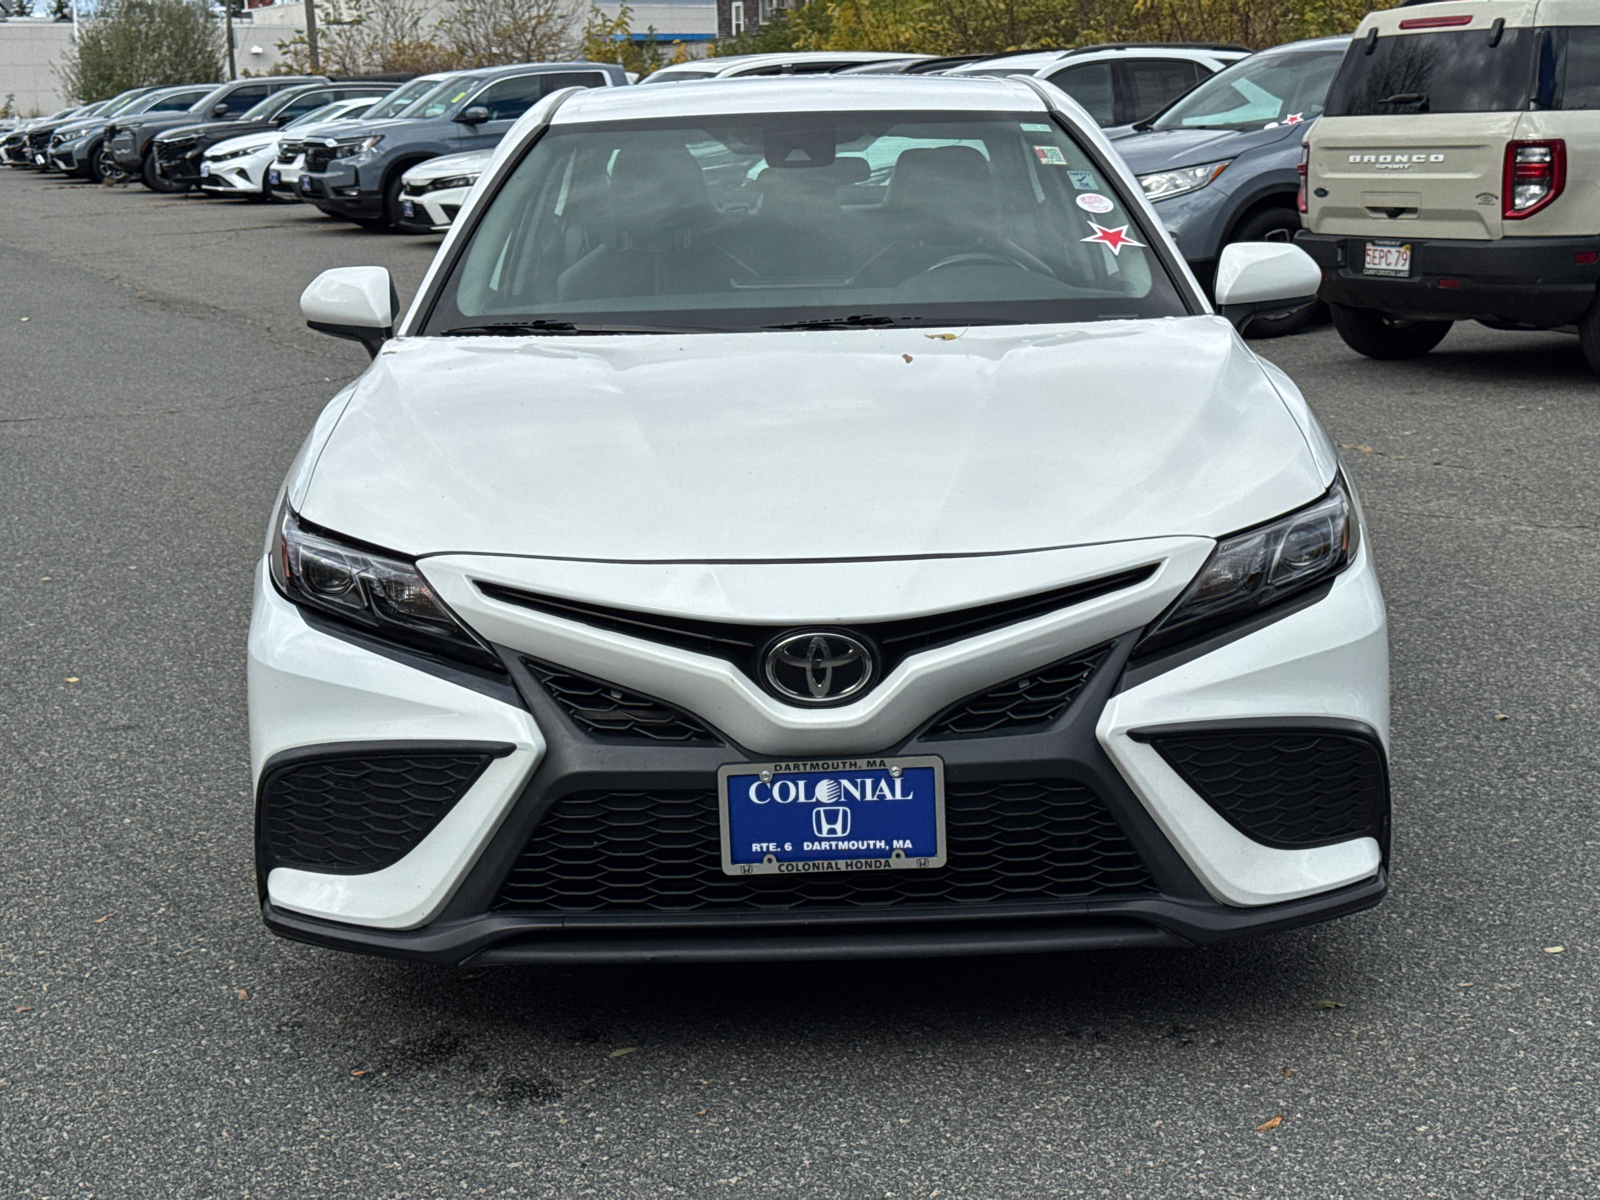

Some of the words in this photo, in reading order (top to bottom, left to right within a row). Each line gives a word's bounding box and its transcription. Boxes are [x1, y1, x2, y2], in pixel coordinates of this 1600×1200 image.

[1348, 154, 1445, 163] BRONCO
[774, 760, 862, 772] DARTMOUTH,
[867, 759, 887, 769] MA
[748, 777, 914, 804] COLONIAL
[751, 842, 781, 852] RTE.
[784, 842, 793, 852] 6
[803, 840, 889, 851] DARTMOUTH,
[892, 839, 913, 849] MA
[777, 861, 841, 873] COLONIAL
[845, 859, 892, 870] HONDA
